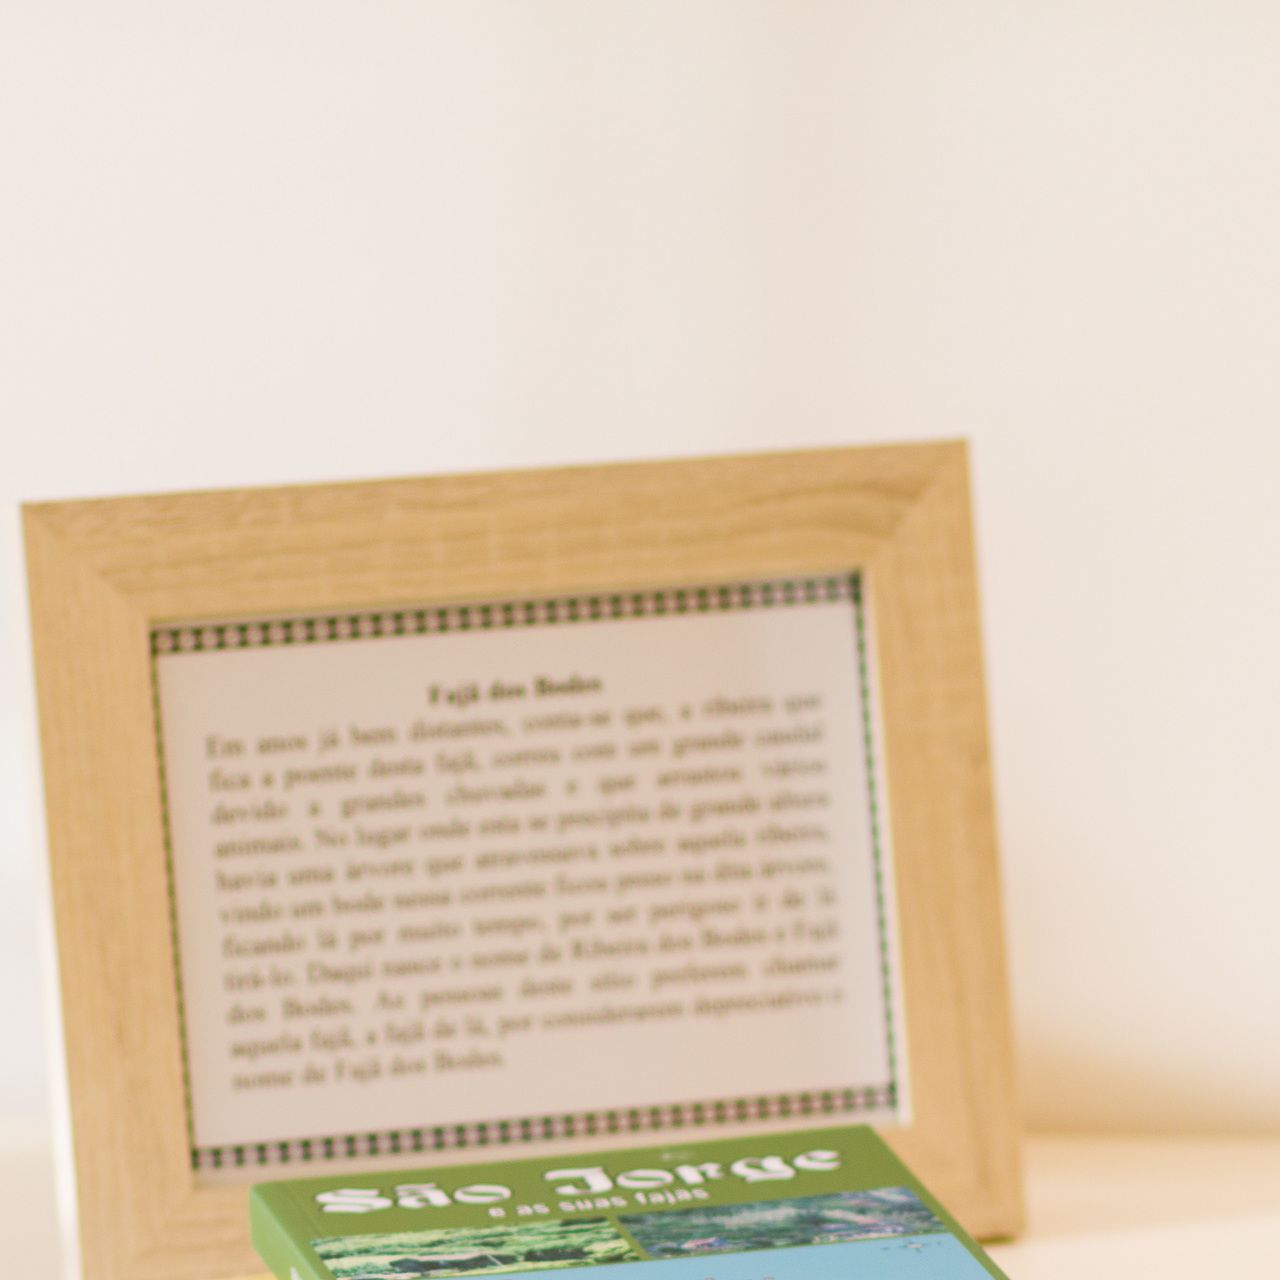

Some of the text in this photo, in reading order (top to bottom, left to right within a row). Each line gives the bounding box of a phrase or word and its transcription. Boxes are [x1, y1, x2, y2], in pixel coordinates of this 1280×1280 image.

[315, 1149, 841, 1214] São Jorge
[487, 1206, 506, 1218] e
[516, 1202, 551, 1216] as
[558, 1196, 628, 1213] suas
